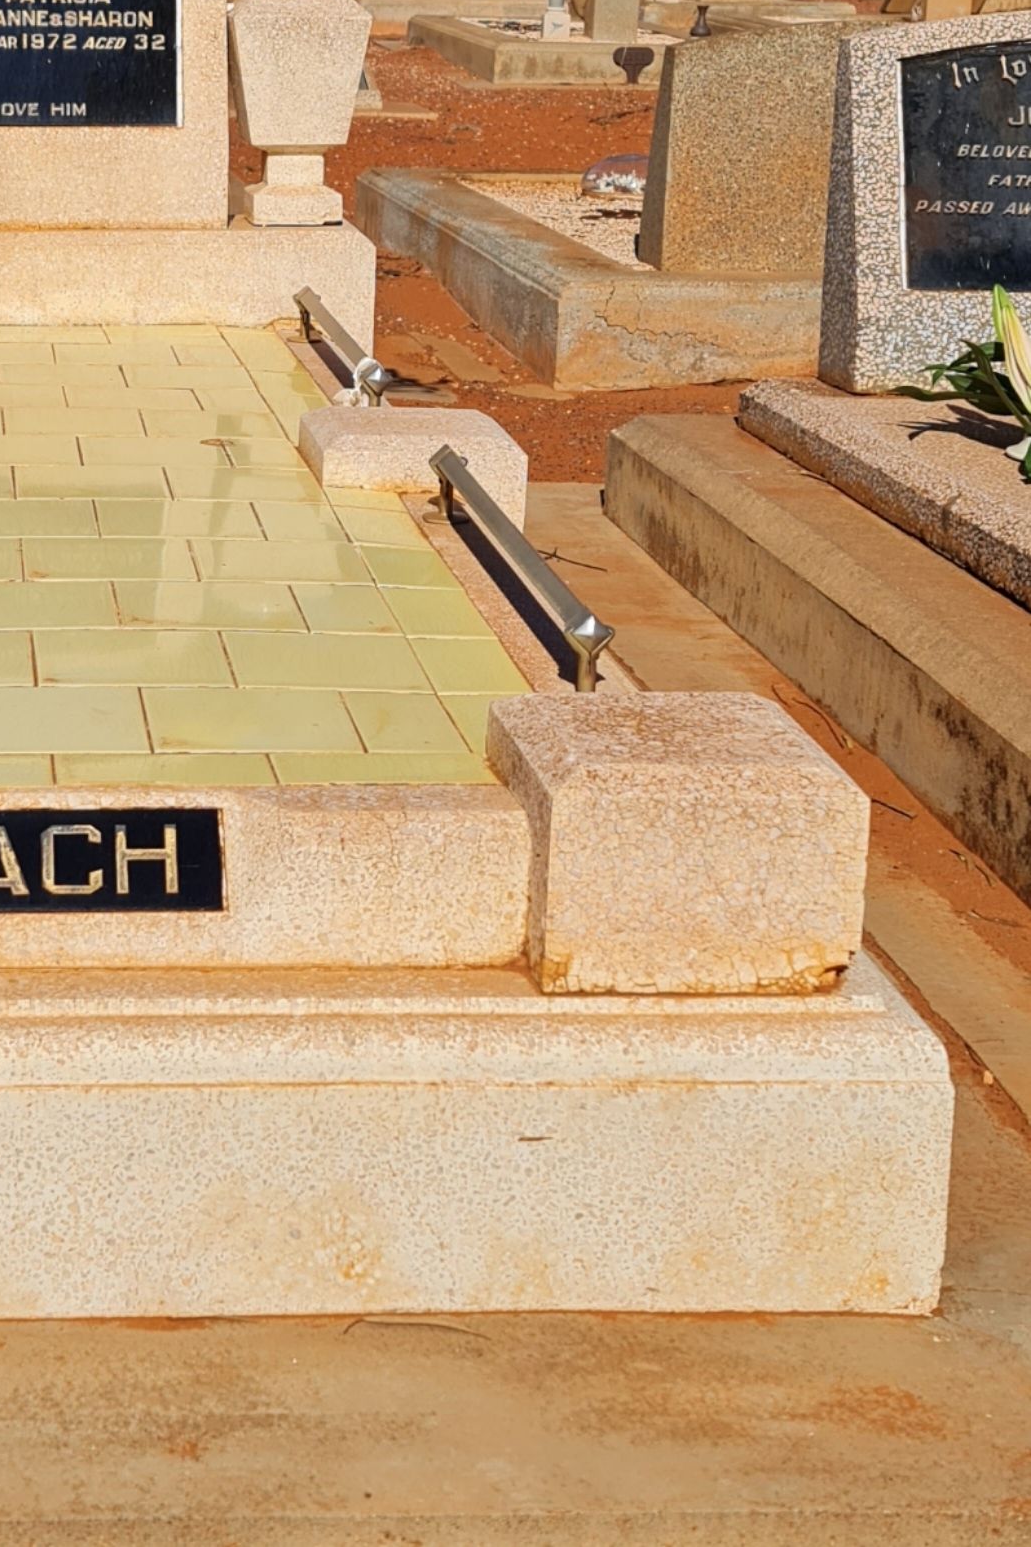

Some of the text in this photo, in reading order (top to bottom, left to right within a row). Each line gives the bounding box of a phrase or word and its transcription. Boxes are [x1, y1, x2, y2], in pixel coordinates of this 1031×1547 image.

[22, 33, 77, 51] 1972
[134, 34, 166, 51] 32
[952, 54, 1031, 89] In Lo
[50, 103, 87, 117] HIM
[1008, 105, 1031, 126] J
[956, 144, 1031, 159] BELOVE
[914, 199, 994, 215] PASSED
